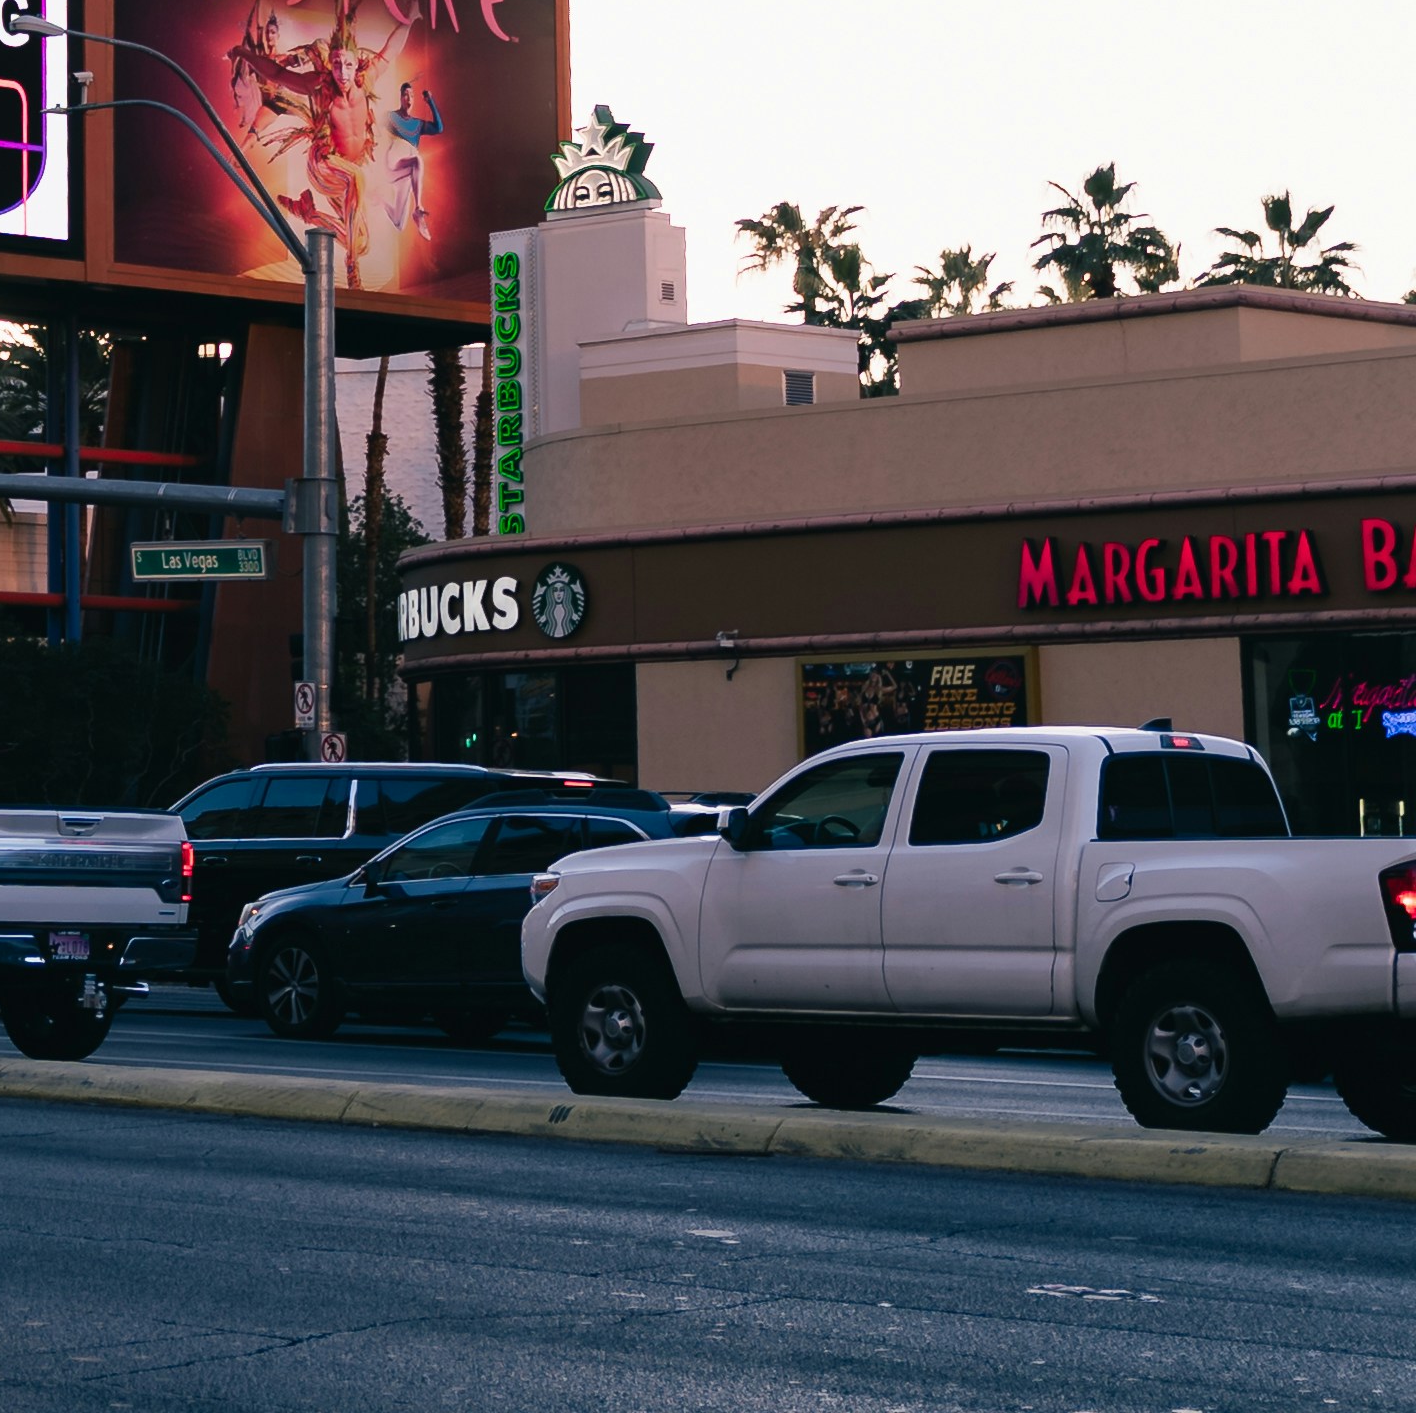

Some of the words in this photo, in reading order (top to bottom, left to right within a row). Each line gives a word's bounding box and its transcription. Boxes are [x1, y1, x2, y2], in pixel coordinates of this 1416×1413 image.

[493, 251, 526, 535] STARBUCKS
[136, 552, 142, 563] S
[161, 552, 183, 569] Las
[184, 551, 219, 573] Vegas
[237, 549, 259, 561] BLVD
[238, 560, 260, 573] 3300
[1017, 528, 1323, 609] MARGARITA
[930, 664, 976, 686] FREE
[927, 689, 978, 702] LINE
[926, 702, 1017, 717] DANCING
[923, 717, 1012, 731] LESSONS
